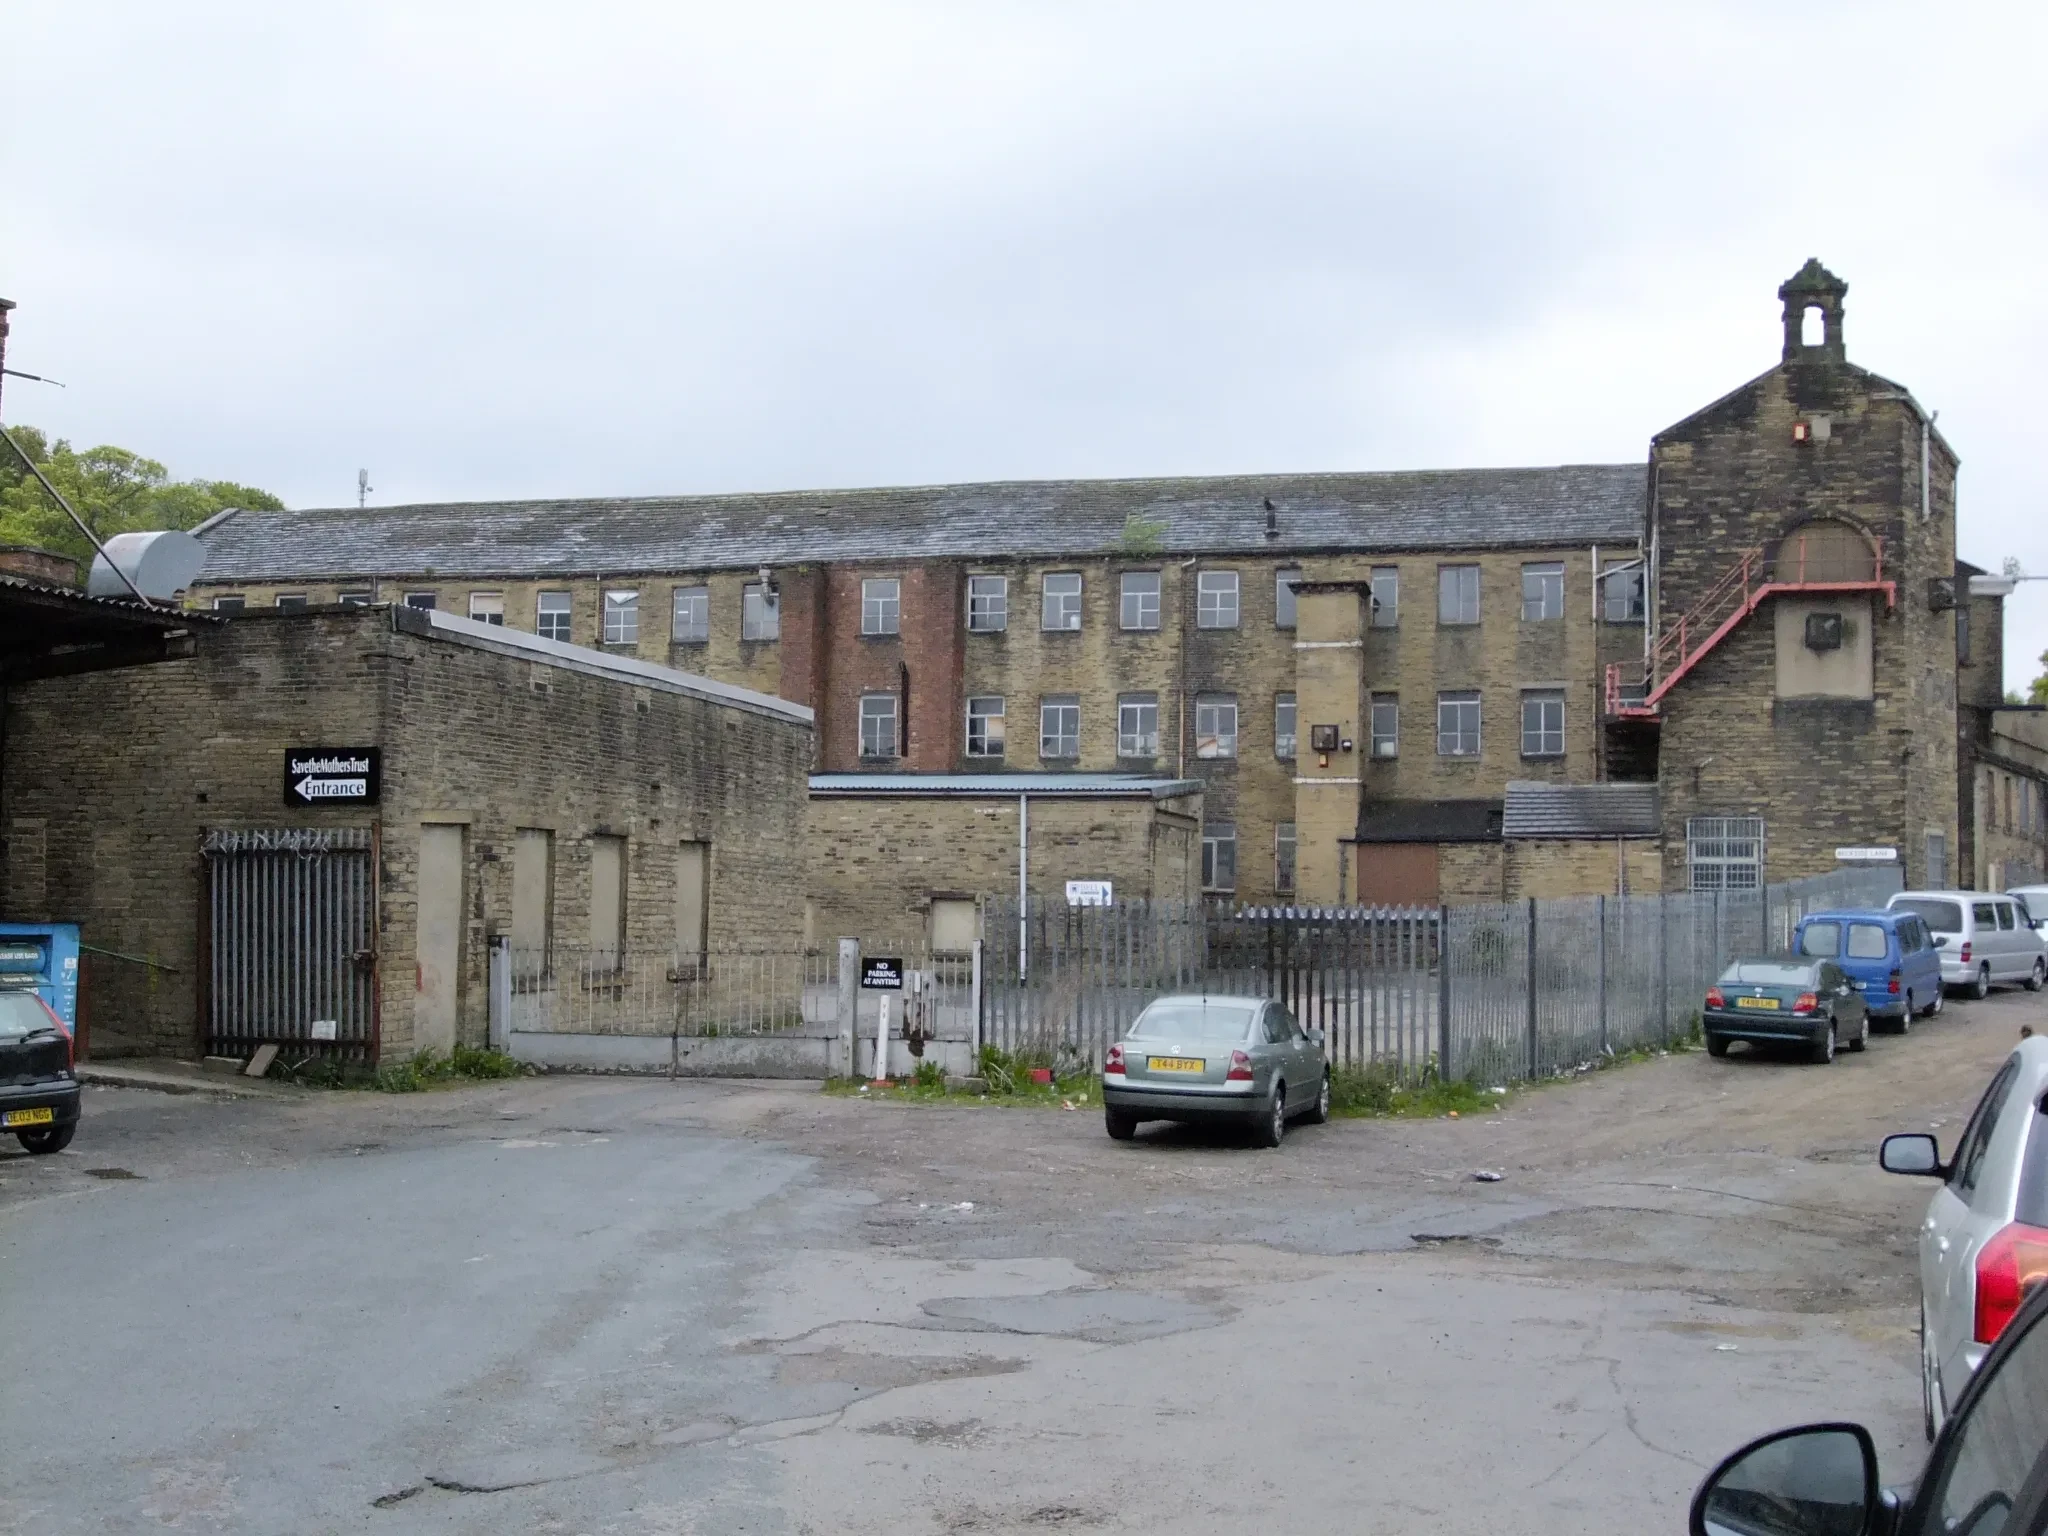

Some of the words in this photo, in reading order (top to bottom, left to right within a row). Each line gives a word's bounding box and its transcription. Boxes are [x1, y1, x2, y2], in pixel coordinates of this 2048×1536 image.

[304, 781, 365, 795] Entrance
[876, 962, 888, 970] NO
[867, 970, 897, 978] PARKING
[863, 977, 872, 985] AT
[872, 978, 901, 986] ANYTIME
[1156, 1059, 1174, 1068] T44
[1176, 1060, 1195, 1070] BYX
